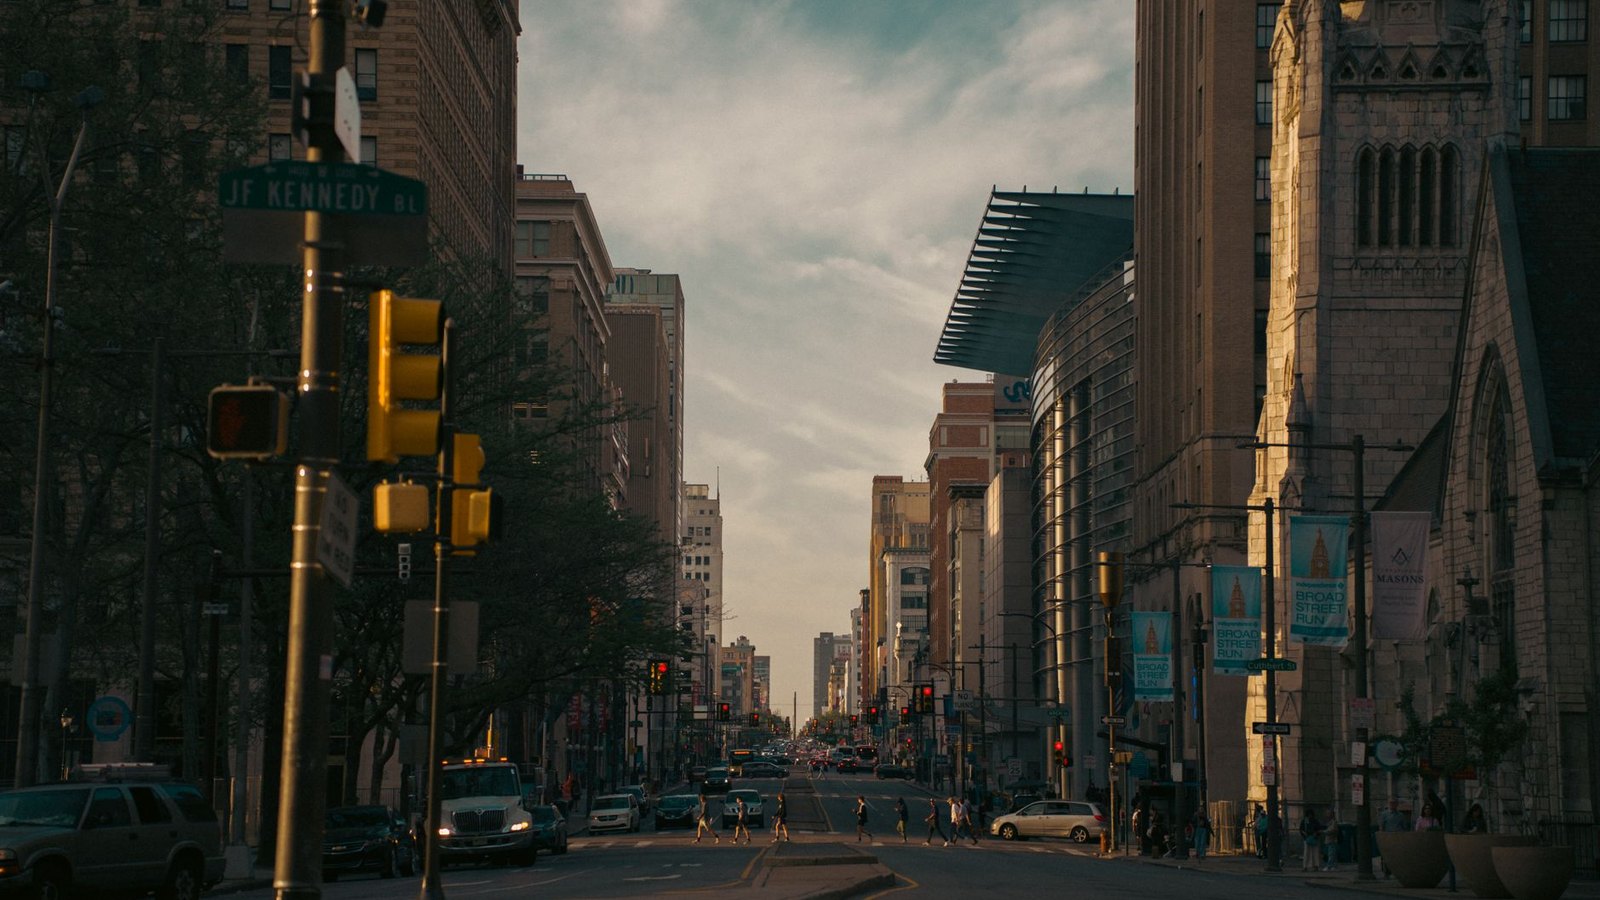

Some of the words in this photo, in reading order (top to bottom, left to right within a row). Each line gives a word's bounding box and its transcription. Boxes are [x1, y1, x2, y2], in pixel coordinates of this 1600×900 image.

[225, 177, 254, 206] JF
[267, 180, 381, 211] KENNEDY
[393, 193, 418, 213] BL
[1376, 574, 1425, 584] MASONS
[1295, 591, 1345, 602] BROAD
[1295, 602, 1345, 614] STREET
[1295, 613, 1326, 625] RUN
[1216, 629, 1259, 639] BROAD
[1216, 639, 1258, 649] STREET
[1217, 649, 1243, 658] RUN
[1136, 663, 1169, 671] BROAD
[1247, 661, 1285, 670] Cuthbert
[1137, 671, 1169, 679] STREET
